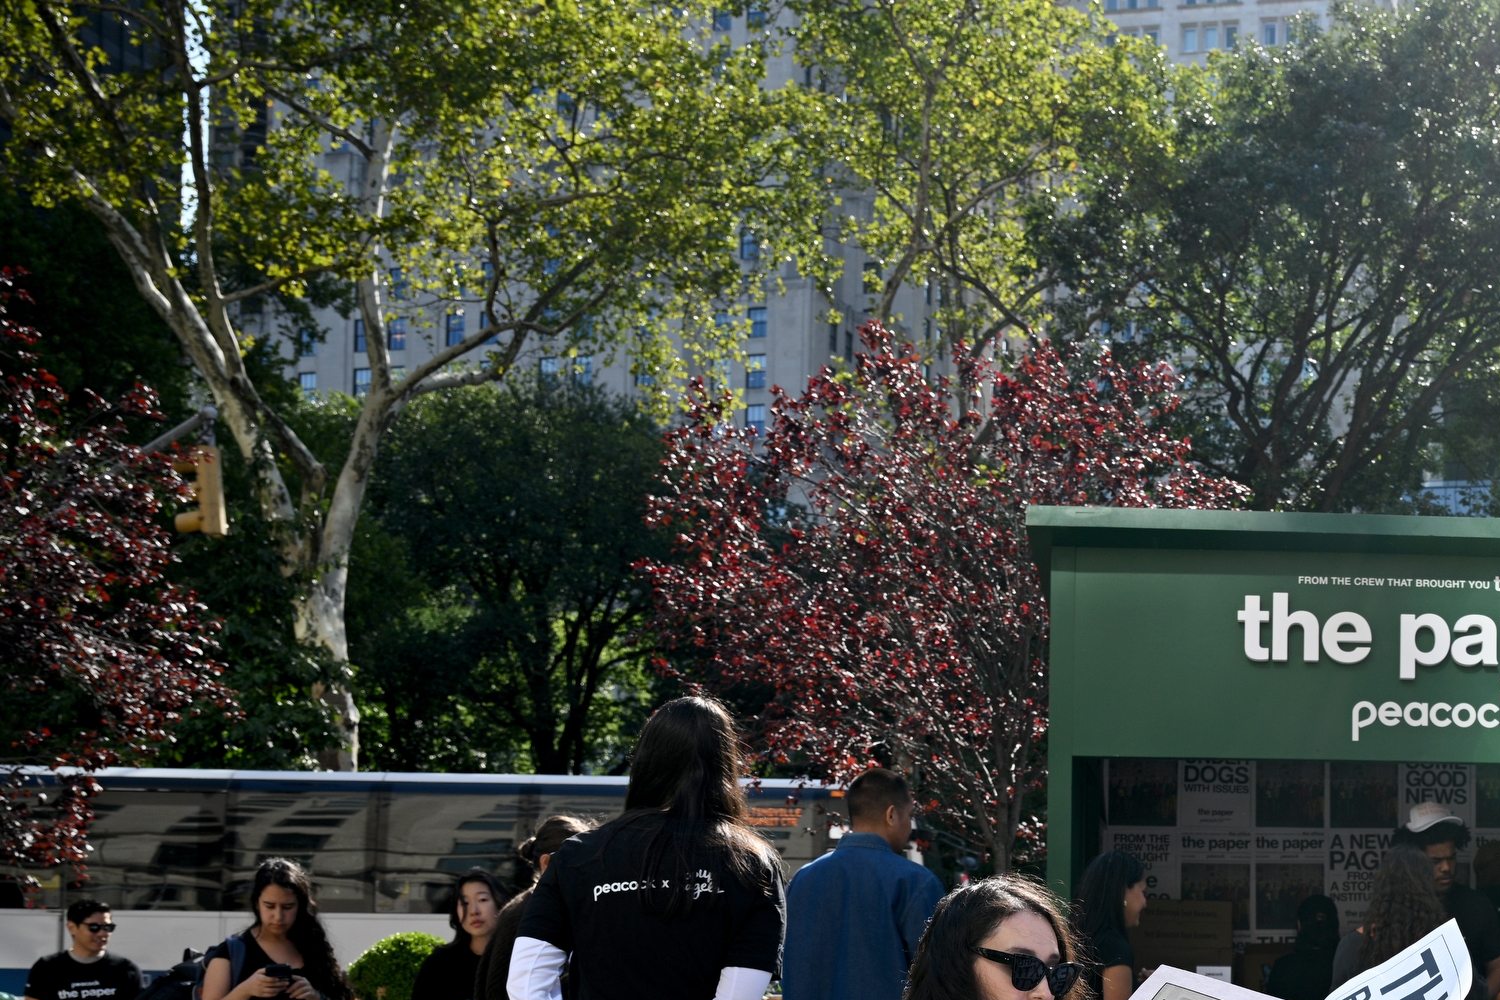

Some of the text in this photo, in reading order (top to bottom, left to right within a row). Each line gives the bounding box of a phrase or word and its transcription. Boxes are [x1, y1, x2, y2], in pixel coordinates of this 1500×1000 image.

[1298, 576, 1328, 585] FROM
[1331, 576, 1351, 586] THE
[1354, 576, 1385, 586] CREW
[1387, 578, 1414, 587] THAT
[1415, 578, 1466, 589] BROUGHT
[1469, 580, 1490, 590] YOU
[1237, 592, 1372, 665] the
[1185, 766, 1249, 784] DOGS
[1406, 770, 1467, 787] GOOD
[1184, 784, 1249, 794] WITH ISSUES
[1406, 788, 1467, 805] NEWS
[1198, 808, 1234, 817] the paper
[1114, 834, 1170, 843] FROM THE
[1182, 837, 1250, 851] the paper
[1256, 837, 1324, 851] the paper
[1330, 834, 1344, 849] A
[1146, 844, 1169, 852] THAT
[1330, 882, 1339, 891] A
[57, 988, 117, 1000] the paper
